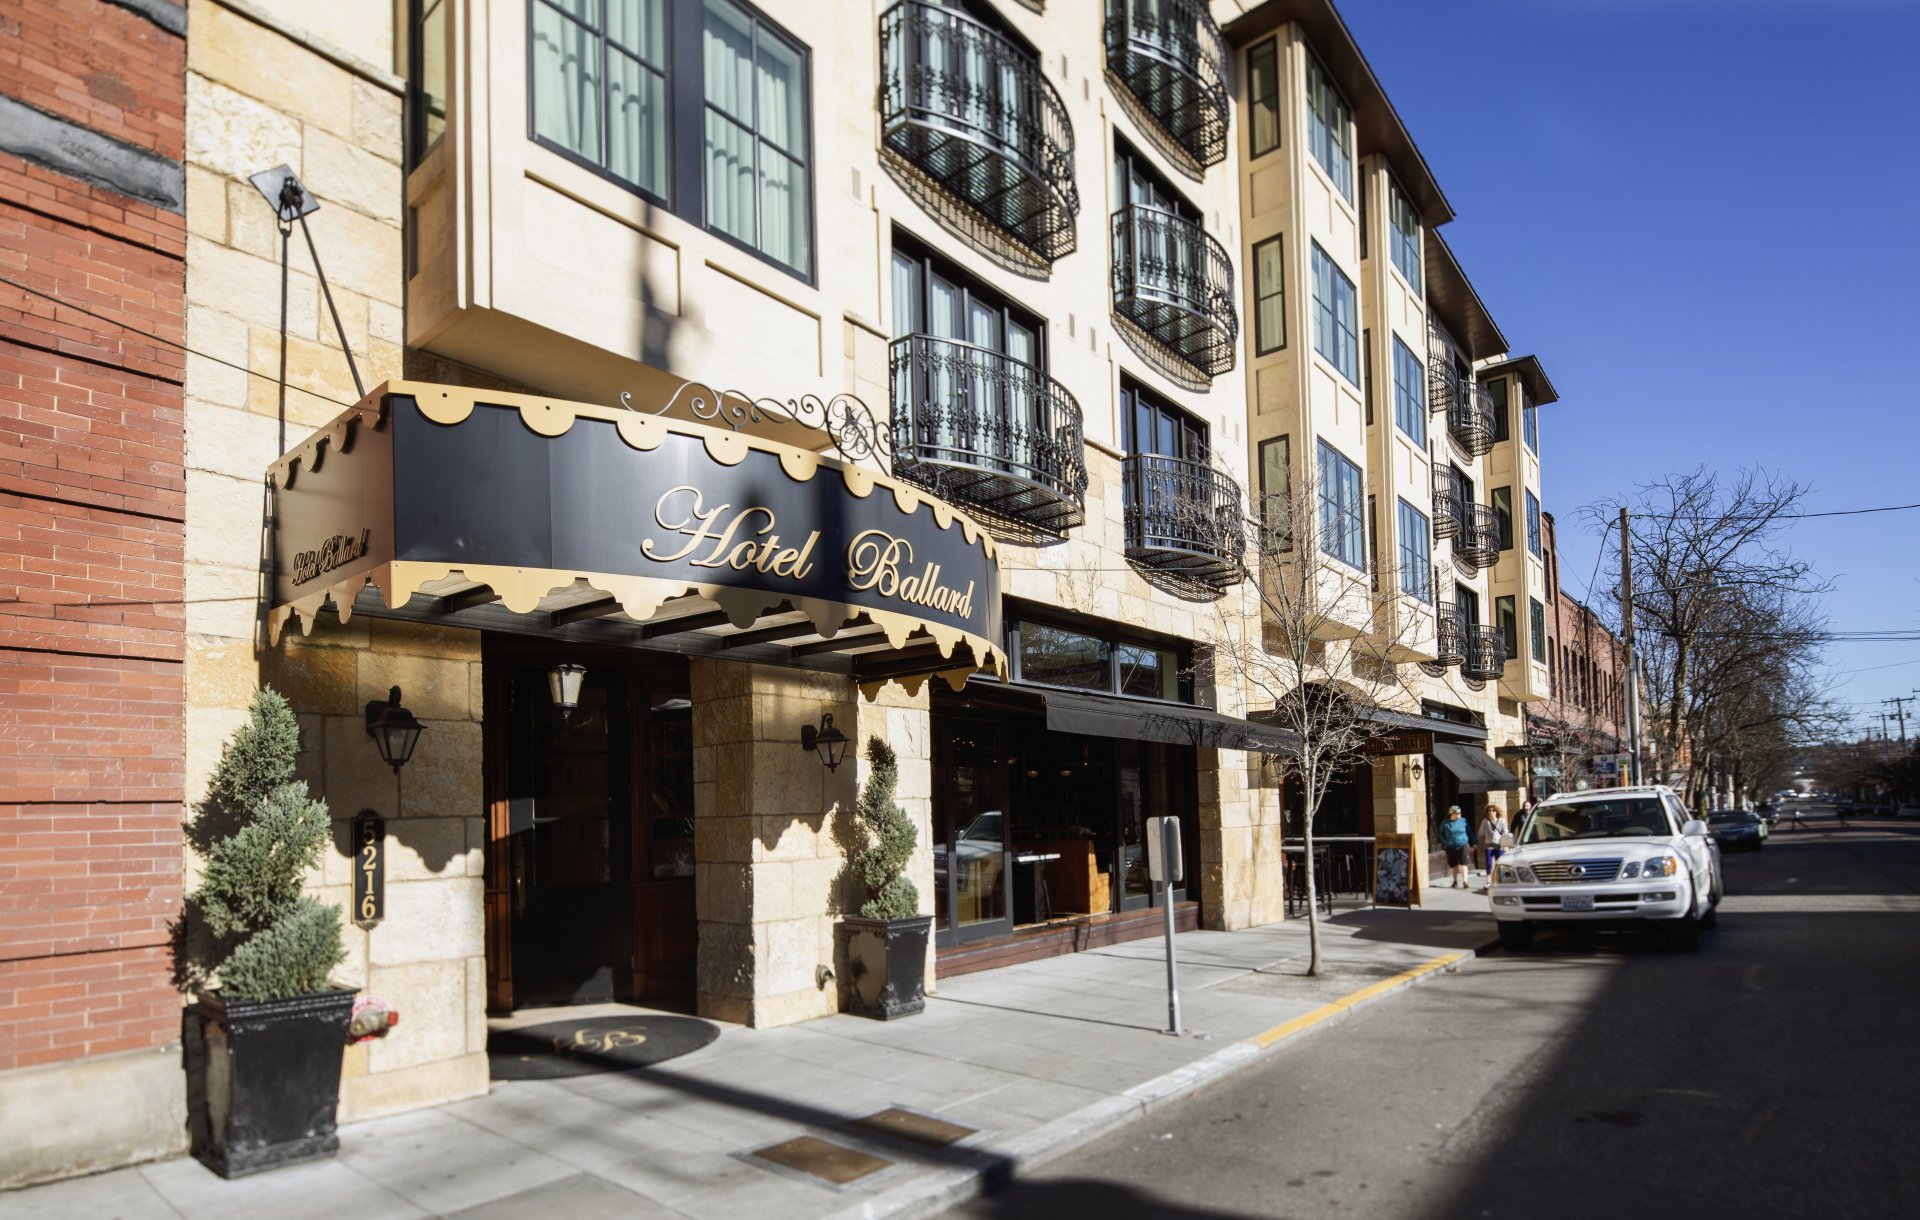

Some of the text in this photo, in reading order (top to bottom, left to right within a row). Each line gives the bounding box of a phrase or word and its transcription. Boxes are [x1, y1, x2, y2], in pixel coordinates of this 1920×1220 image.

[319, 528, 367, 573] Ballard
[640, 485, 975, 620] Hotel Ballard
[361, 821, 377, 919] 5216
